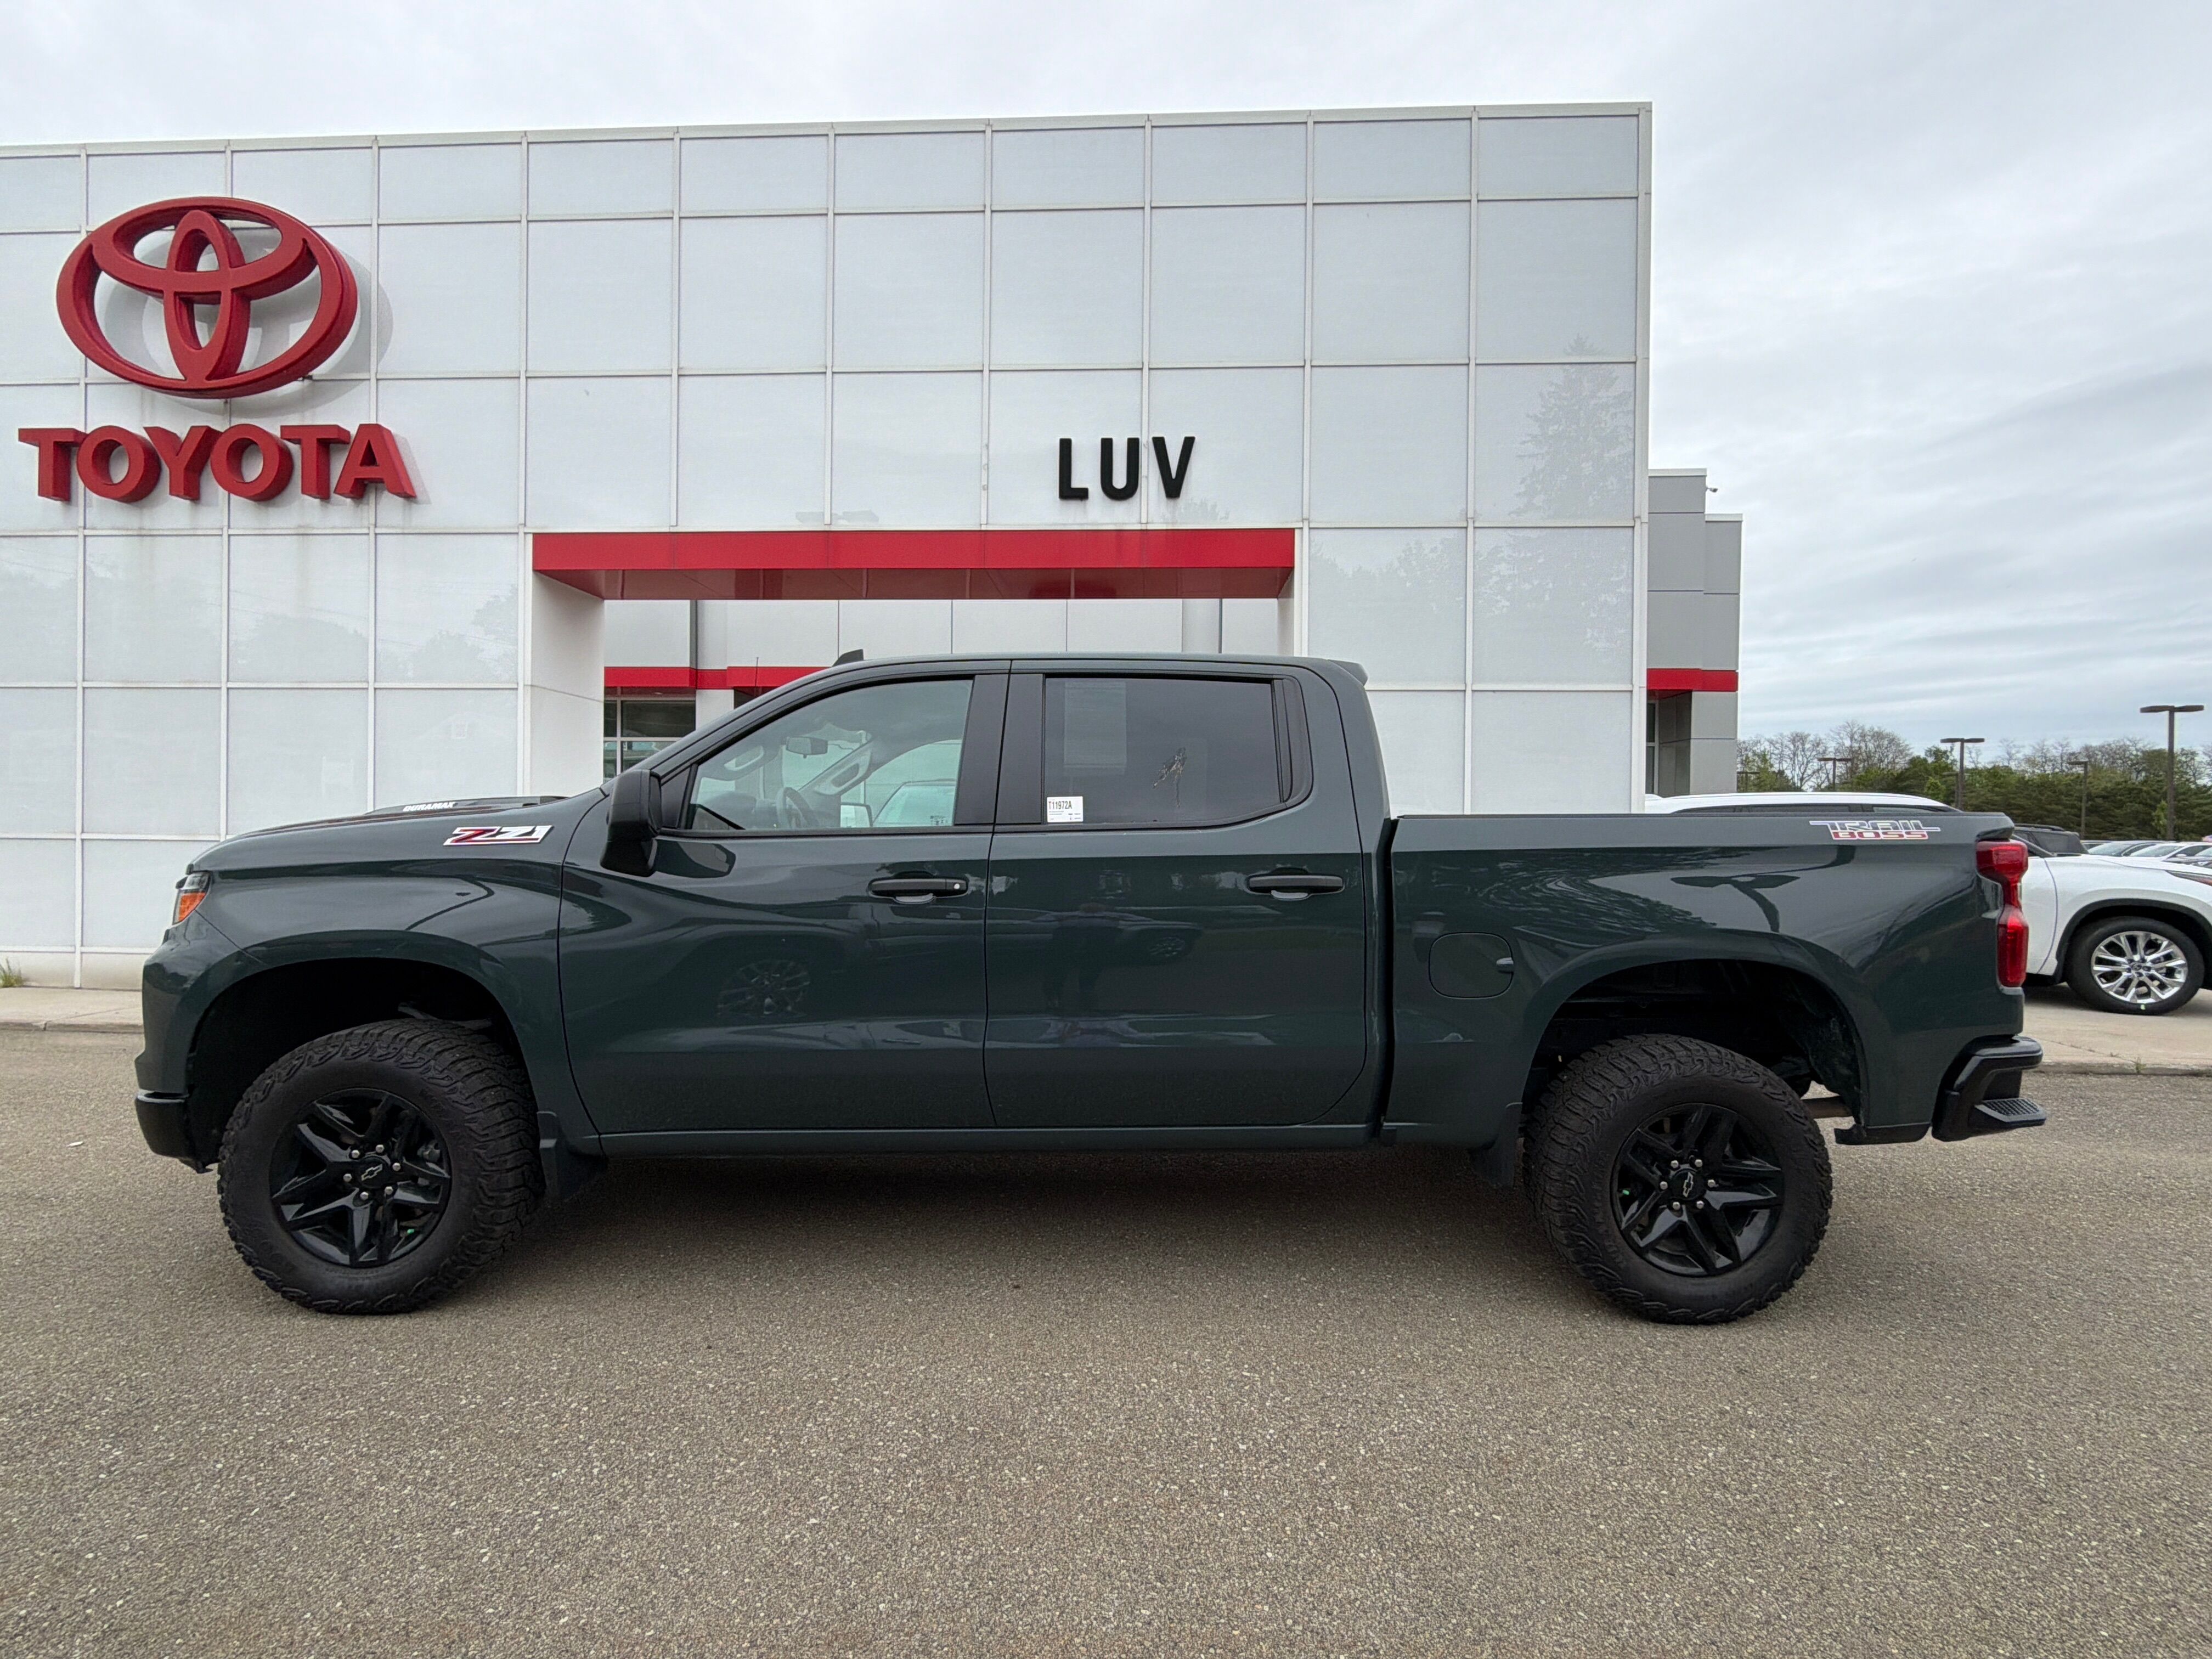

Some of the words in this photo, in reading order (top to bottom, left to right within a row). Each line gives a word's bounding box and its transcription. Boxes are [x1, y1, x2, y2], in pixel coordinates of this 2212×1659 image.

[19, 424, 416, 502] TOYOTA
[1058, 436, 1195, 500] LUV
[403, 802, 456, 812] DURAMAX
[1048, 800, 1073, 810] T11972A
[1809, 820, 1941, 832] TRAIL
[443, 825, 553, 846] Z71
[1832, 830, 1929, 840] BOSS
